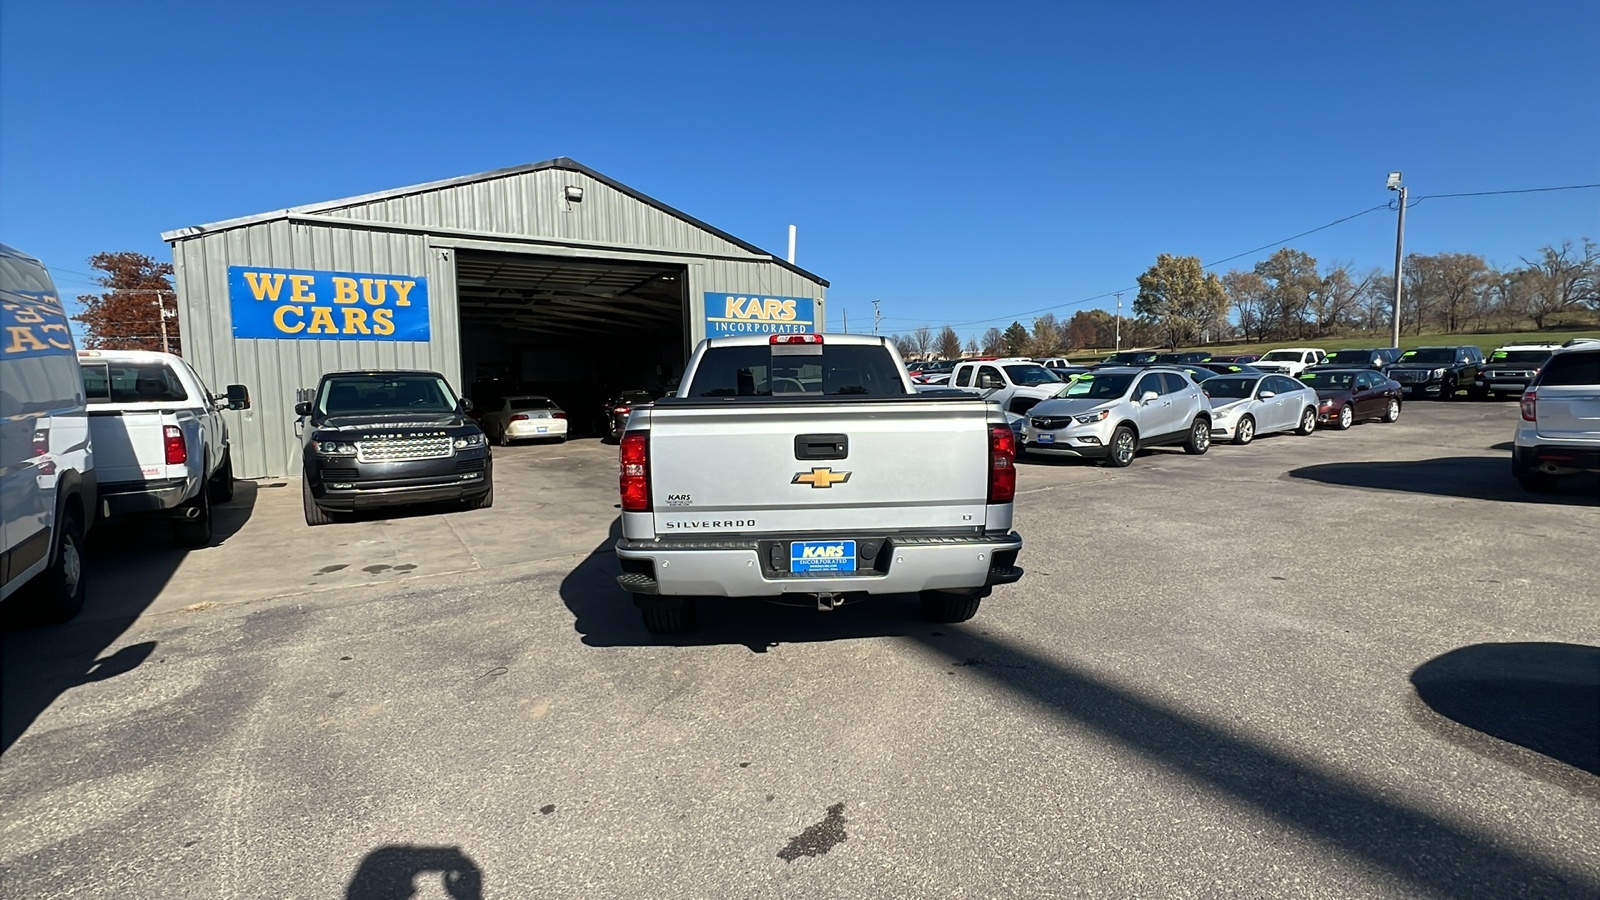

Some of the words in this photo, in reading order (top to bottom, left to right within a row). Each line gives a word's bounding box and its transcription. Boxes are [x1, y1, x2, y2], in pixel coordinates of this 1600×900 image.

[244, 272, 316, 302] WE
[332, 277, 416, 306] BUY
[725, 296, 797, 321] KARS
[273, 305, 395, 335] CARS
[715, 322, 807, 334] INCORPORATED
[666, 519, 756, 529] SILVERADO
[802, 545, 844, 558] KARS
